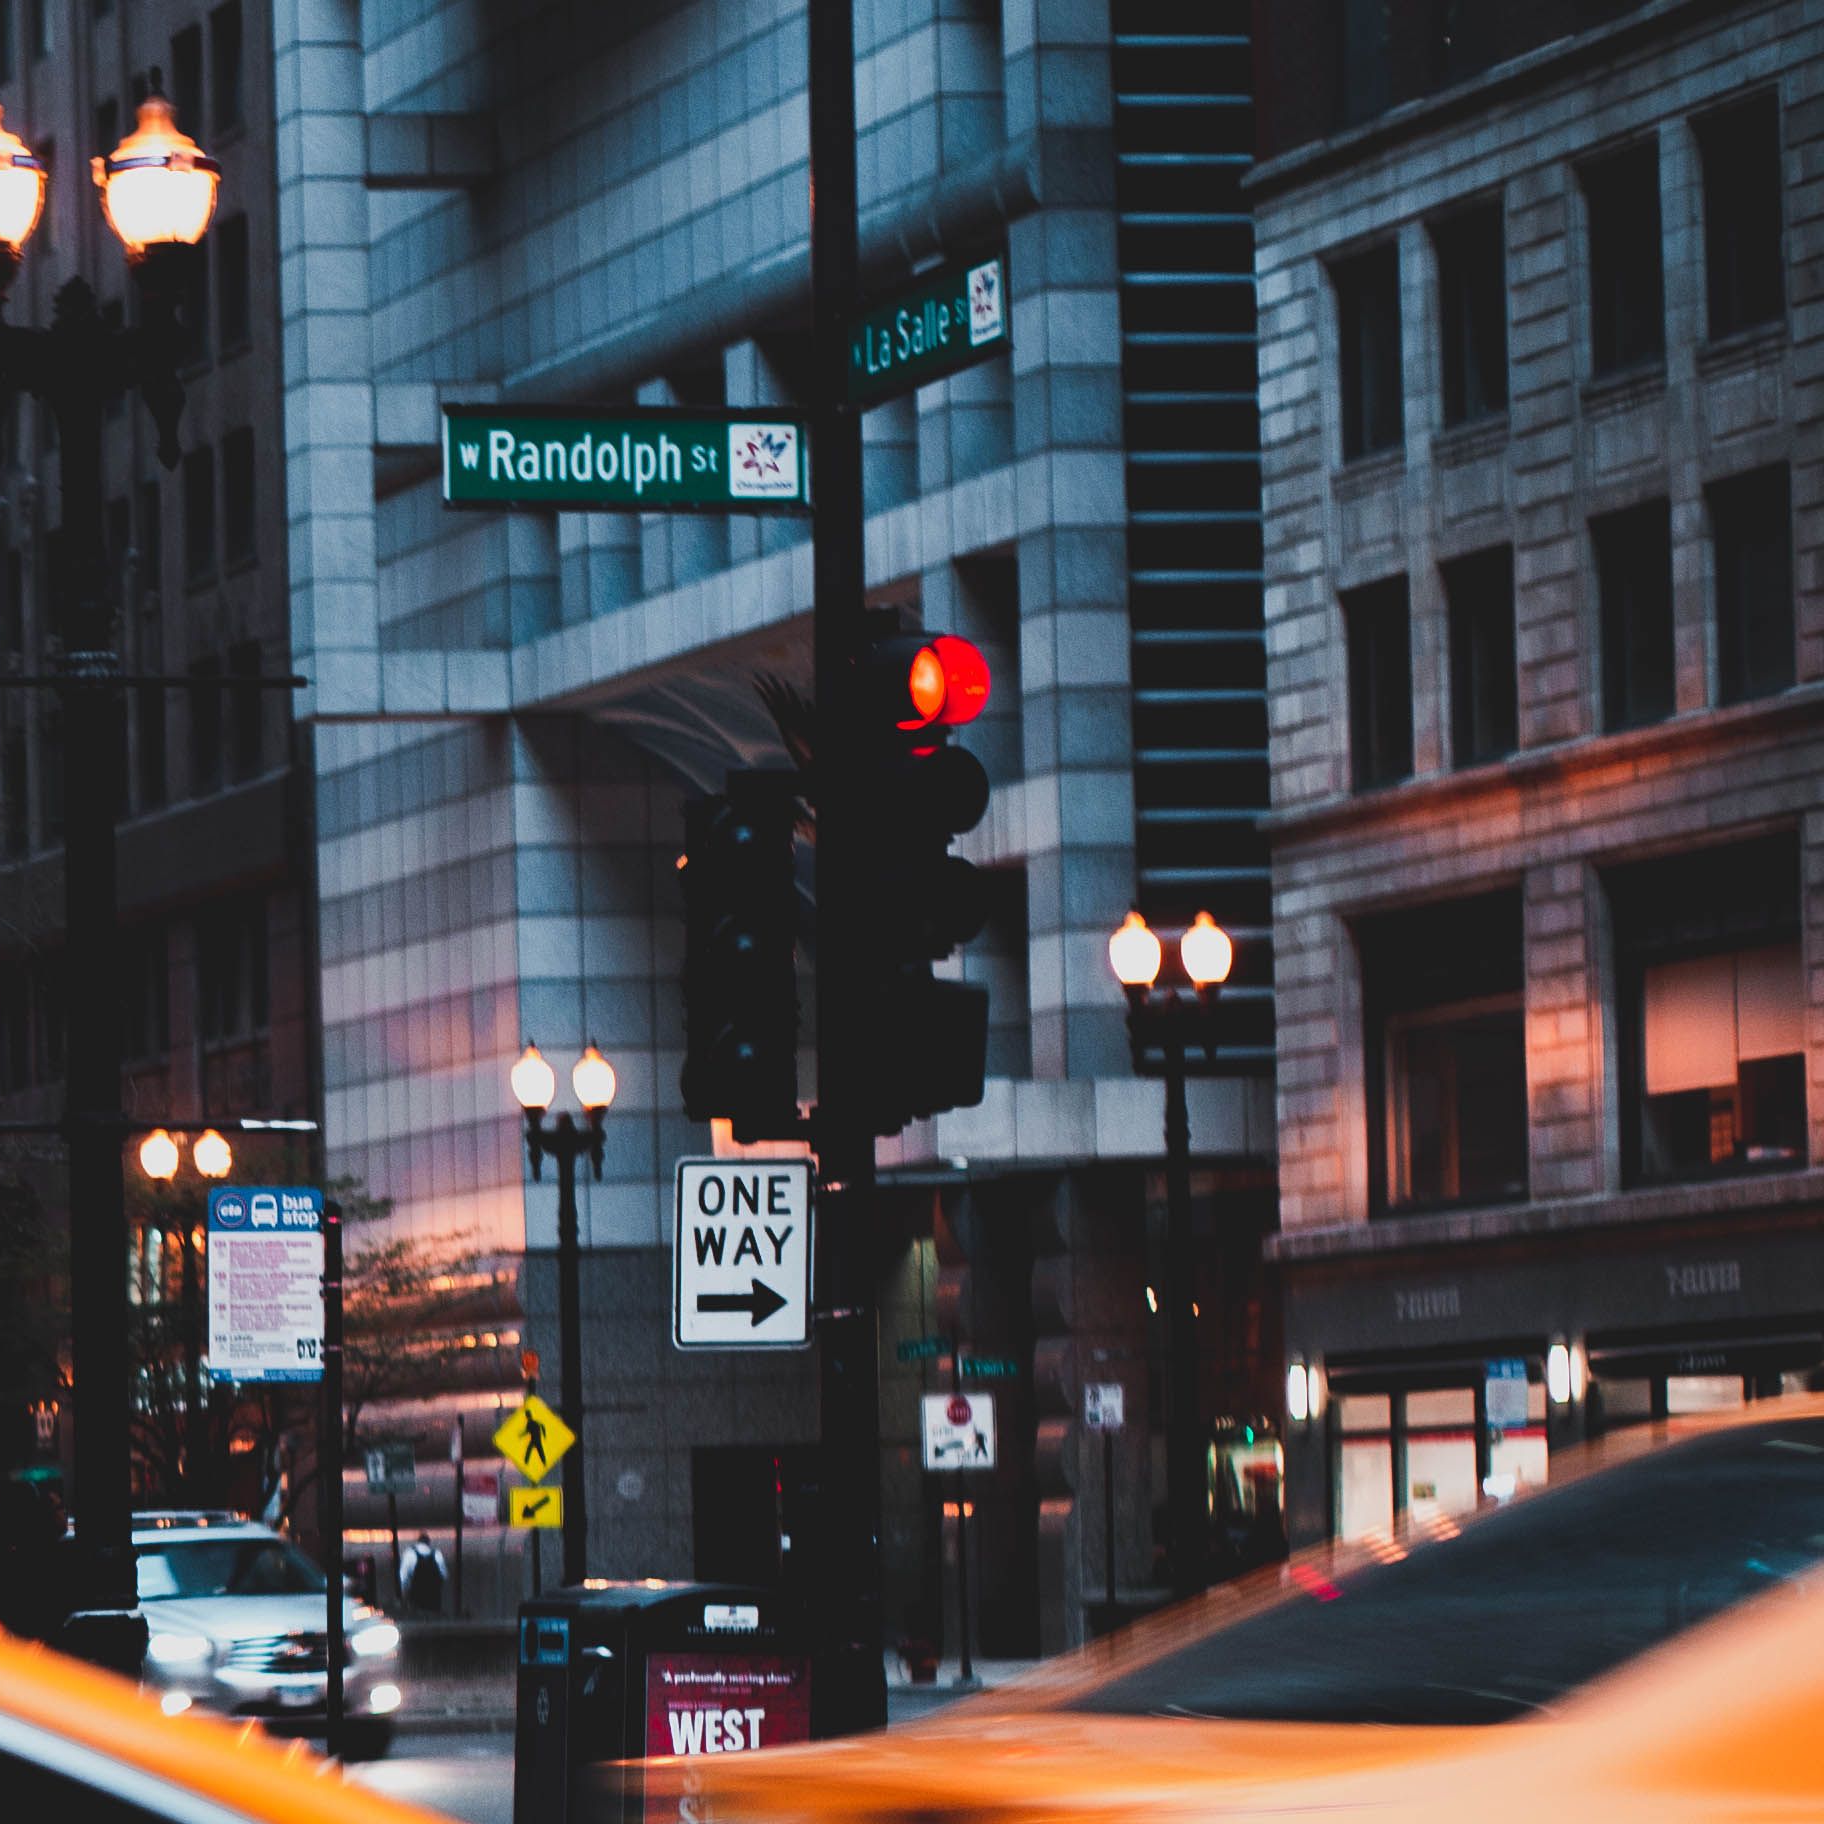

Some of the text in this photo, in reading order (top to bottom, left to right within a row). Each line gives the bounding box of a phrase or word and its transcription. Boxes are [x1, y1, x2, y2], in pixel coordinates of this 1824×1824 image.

[866, 324, 892, 375] La
[896, 299, 950, 361] Salle
[458, 429, 719, 495] W Randolph St
[281, 1193, 314, 1210] bus
[698, 1175, 792, 1216] ONE
[282, 1210, 320, 1229] stop
[693, 1225, 794, 1267] WAY
[668, 1708, 765, 1755] WEST
